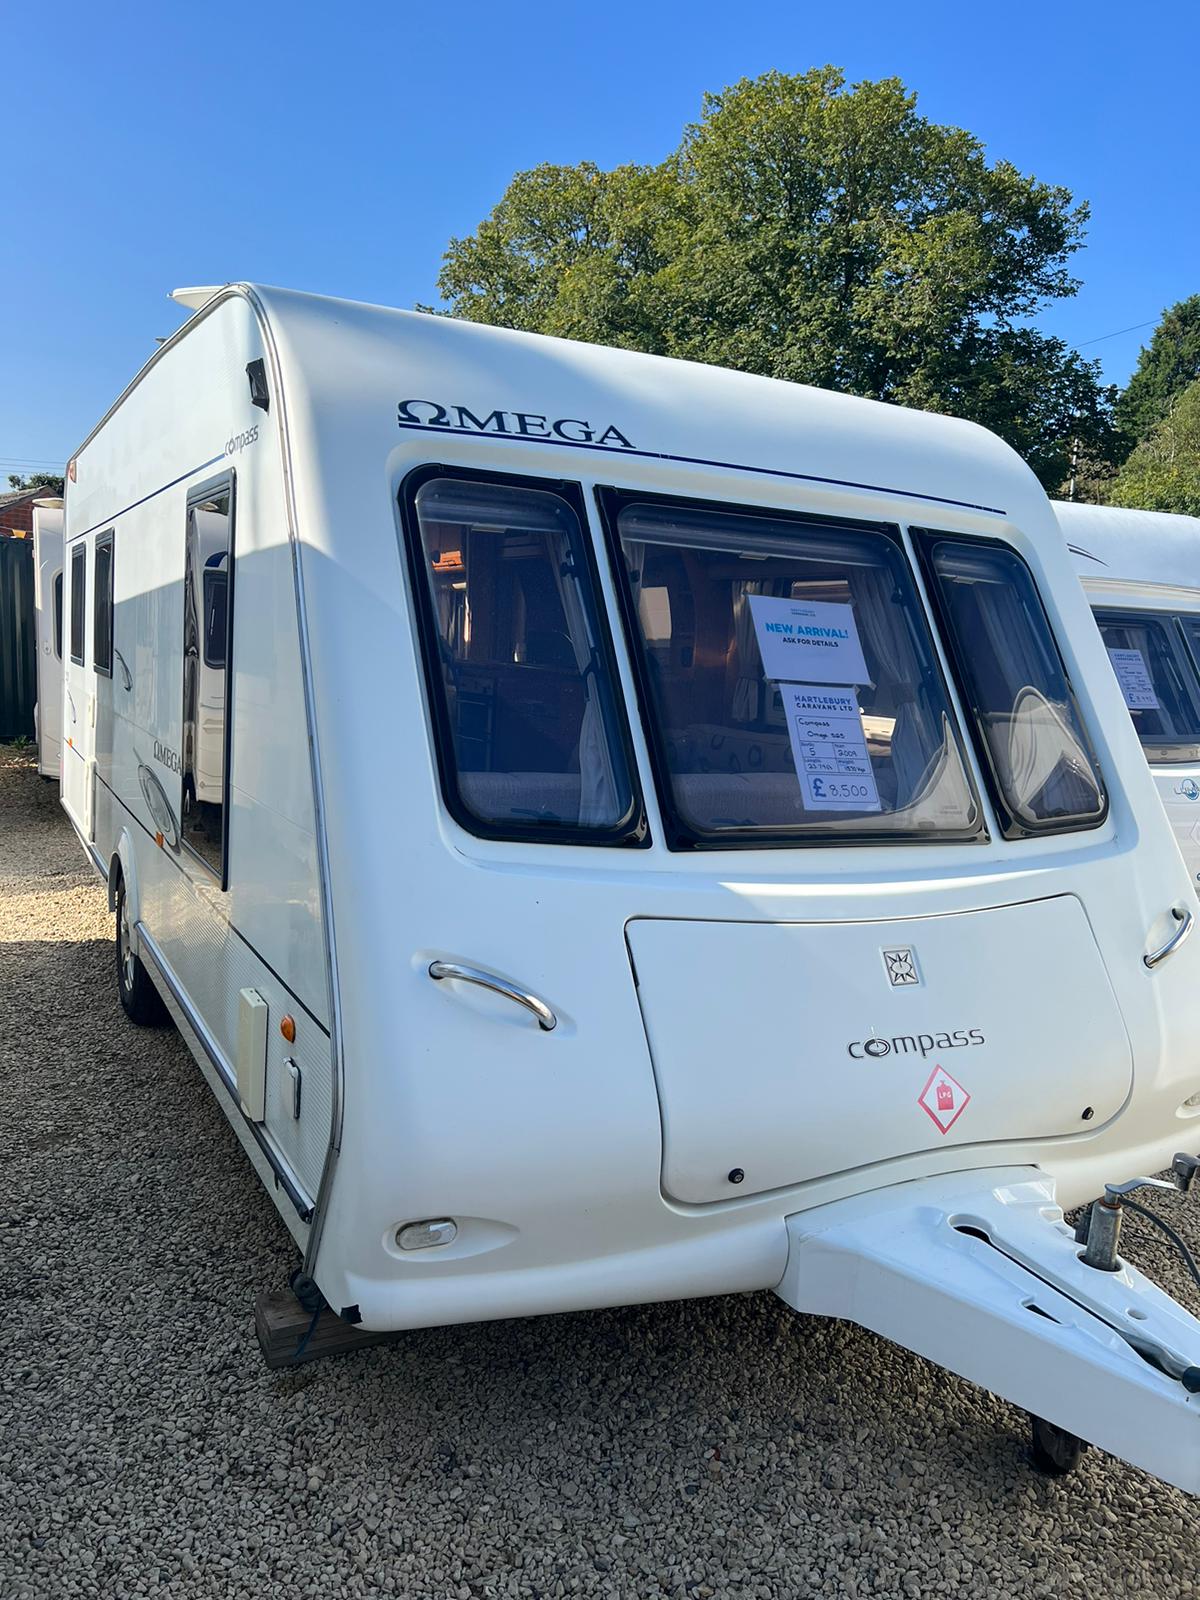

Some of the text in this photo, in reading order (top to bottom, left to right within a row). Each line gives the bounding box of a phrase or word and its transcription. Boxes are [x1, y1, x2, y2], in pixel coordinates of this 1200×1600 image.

[765, 622, 849, 639] NEW ARRIVAL!
[782, 637, 839, 648] ASK FOR DETAILS
[794, 695, 851, 705] HARTLEBURY
[796, 702, 837, 711] CARAVANS
[798, 717, 830, 728] Compass
[809, 747, 816, 757] 5
[848, 1028, 985, 1059] compass
[938, 1091, 952, 1099] LPG
